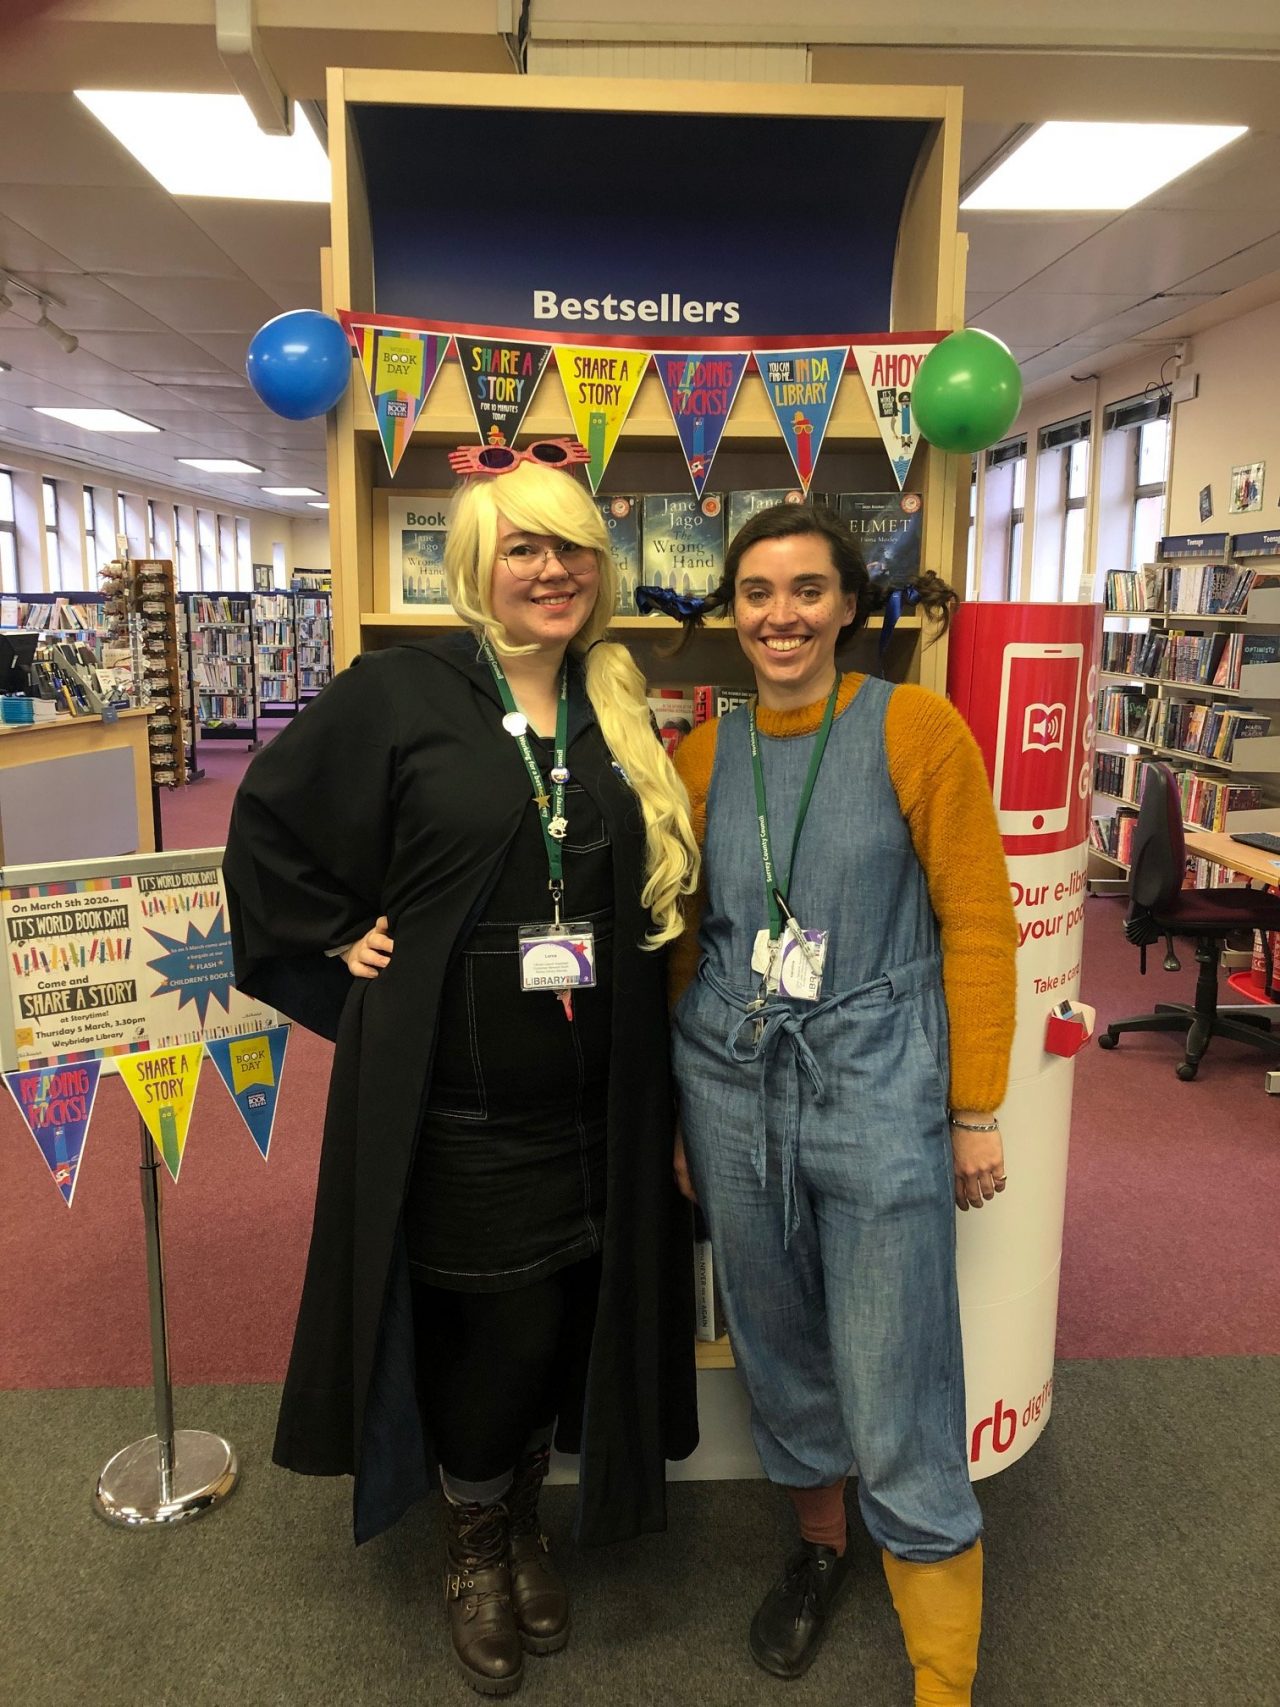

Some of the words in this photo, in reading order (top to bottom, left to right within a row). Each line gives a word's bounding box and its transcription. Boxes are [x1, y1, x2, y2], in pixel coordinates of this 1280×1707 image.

[533, 290, 740, 324] Bestsellers
[383, 353, 417, 365] BOOK
[387, 364, 410, 375] DAY
[472, 346, 521, 375] SHARE
[522, 351, 533, 377] A
[573, 356, 618, 381] SHARE
[619, 360, 629, 382] A
[811, 357, 831, 382] DA
[667, 360, 733, 388] READING
[477, 375, 525, 403] STORY
[578, 382, 622, 406] STORY
[774, 381, 828, 407] LIBRARY
[480, 402, 490, 411] FOR
[661, 498, 697, 516] Jane
[406, 511, 446, 527] Book
[669, 512, 703, 529] Jago
[849, 519, 911, 533] ELMET
[653, 540, 705, 555] Wrong
[673, 554, 714, 569] Hand
[519, 735, 532, 761] Working
[528, 760, 536, 770] for
[757, 815, 766, 837] Council
[761, 837, 769, 861] County
[140, 877, 156, 891] IT'S
[155, 874, 182, 889] WORLD
[181, 871, 201, 886] BOOK
[201, 869, 217, 883] DAY!
[765, 861, 773, 883] Surrey
[1010, 881, 1049, 907] Our
[12, 904, 28, 914] On
[30, 899, 62, 911] March
[64, 898, 82, 908] 5th
[12, 917, 36, 938] IT'S
[35, 912, 73, 935] WORLD
[74, 908, 104, 931] BOOK
[103, 907, 128, 928] DAY!
[1016, 913, 1063, 948] your
[196, 961, 217, 971] FLASH
[37, 980, 67, 990] Come
[69, 975, 89, 986] and
[169, 975, 209, 987] CHILDREN'S
[209, 971, 228, 981] BOOK
[1033, 976, 1058, 995] Take
[1060, 973, 1066, 985] a
[23, 989, 72, 1017] SHARE
[75, 986, 87, 1009] A
[88, 980, 133, 1007] STORY
[35, 1026, 76, 1039] Thursday
[84, 1021, 114, 1031] March,
[114, 1016, 146, 1029] 3.30pm
[70, 1010, 109, 1023] Storytime!
[51, 1036, 95, 1048] Weybridge
[95, 1032, 124, 1042] Library
[136, 1056, 177, 1081] SHARE
[180, 1054, 189, 1073] A
[235, 1050, 265, 1063] BOOK
[240, 1061, 261, 1072] DAY
[20, 1068, 90, 1105] READING
[144, 1077, 184, 1104] STORY
[970, 1398, 1017, 1463] rb
